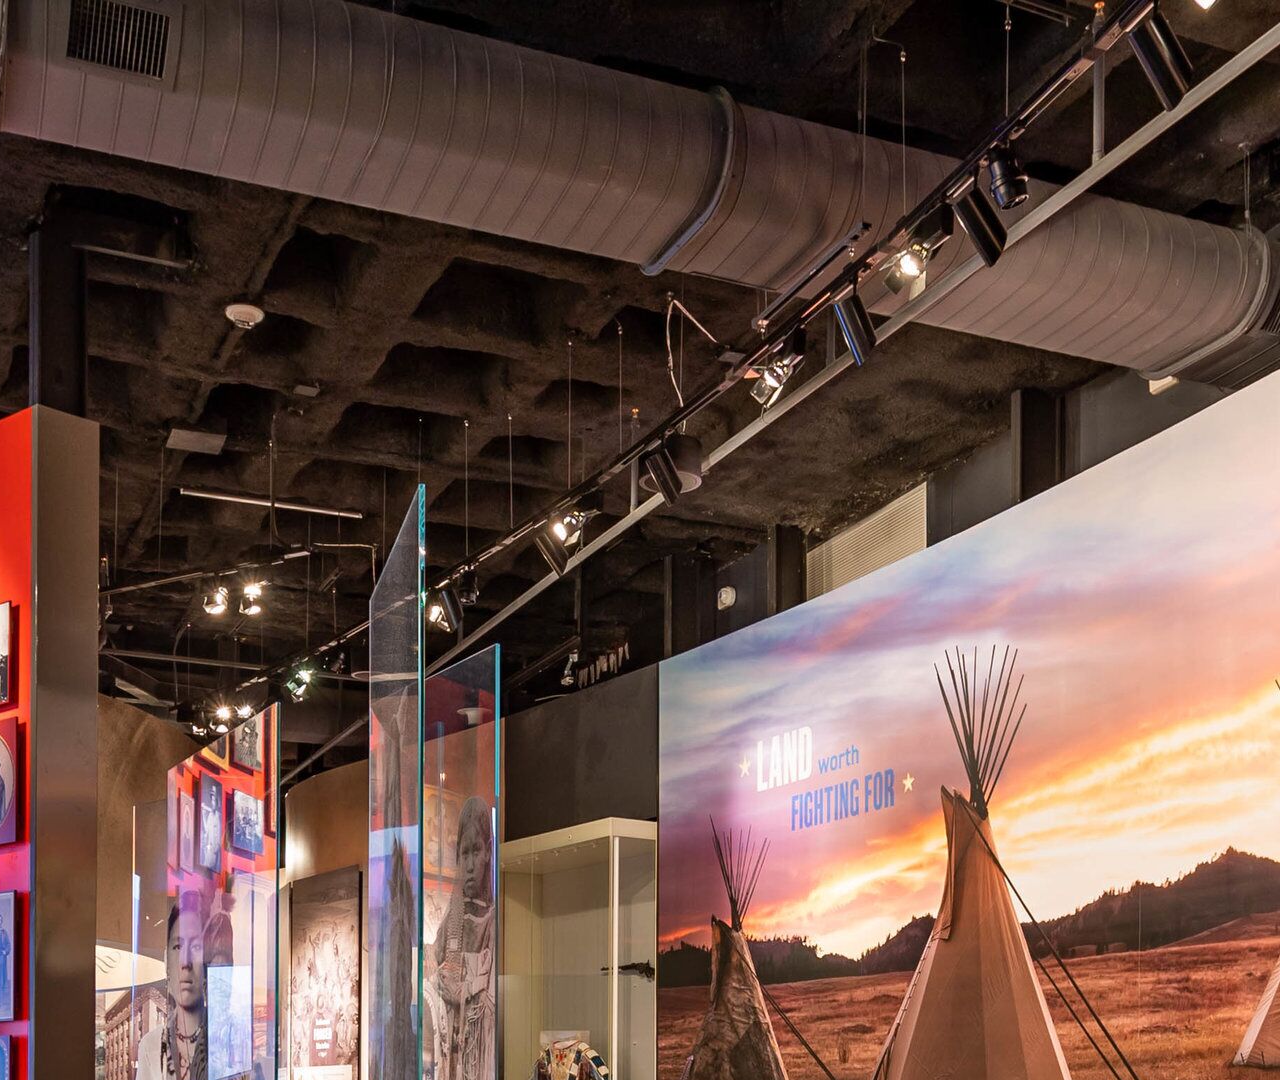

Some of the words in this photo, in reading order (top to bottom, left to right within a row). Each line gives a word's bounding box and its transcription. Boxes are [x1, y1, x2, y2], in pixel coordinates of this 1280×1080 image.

[756, 725, 813, 792] LAND
[817, 744, 860, 774] worth
[790, 778, 860, 831] FIGHTING
[864, 768, 896, 813] FOR
